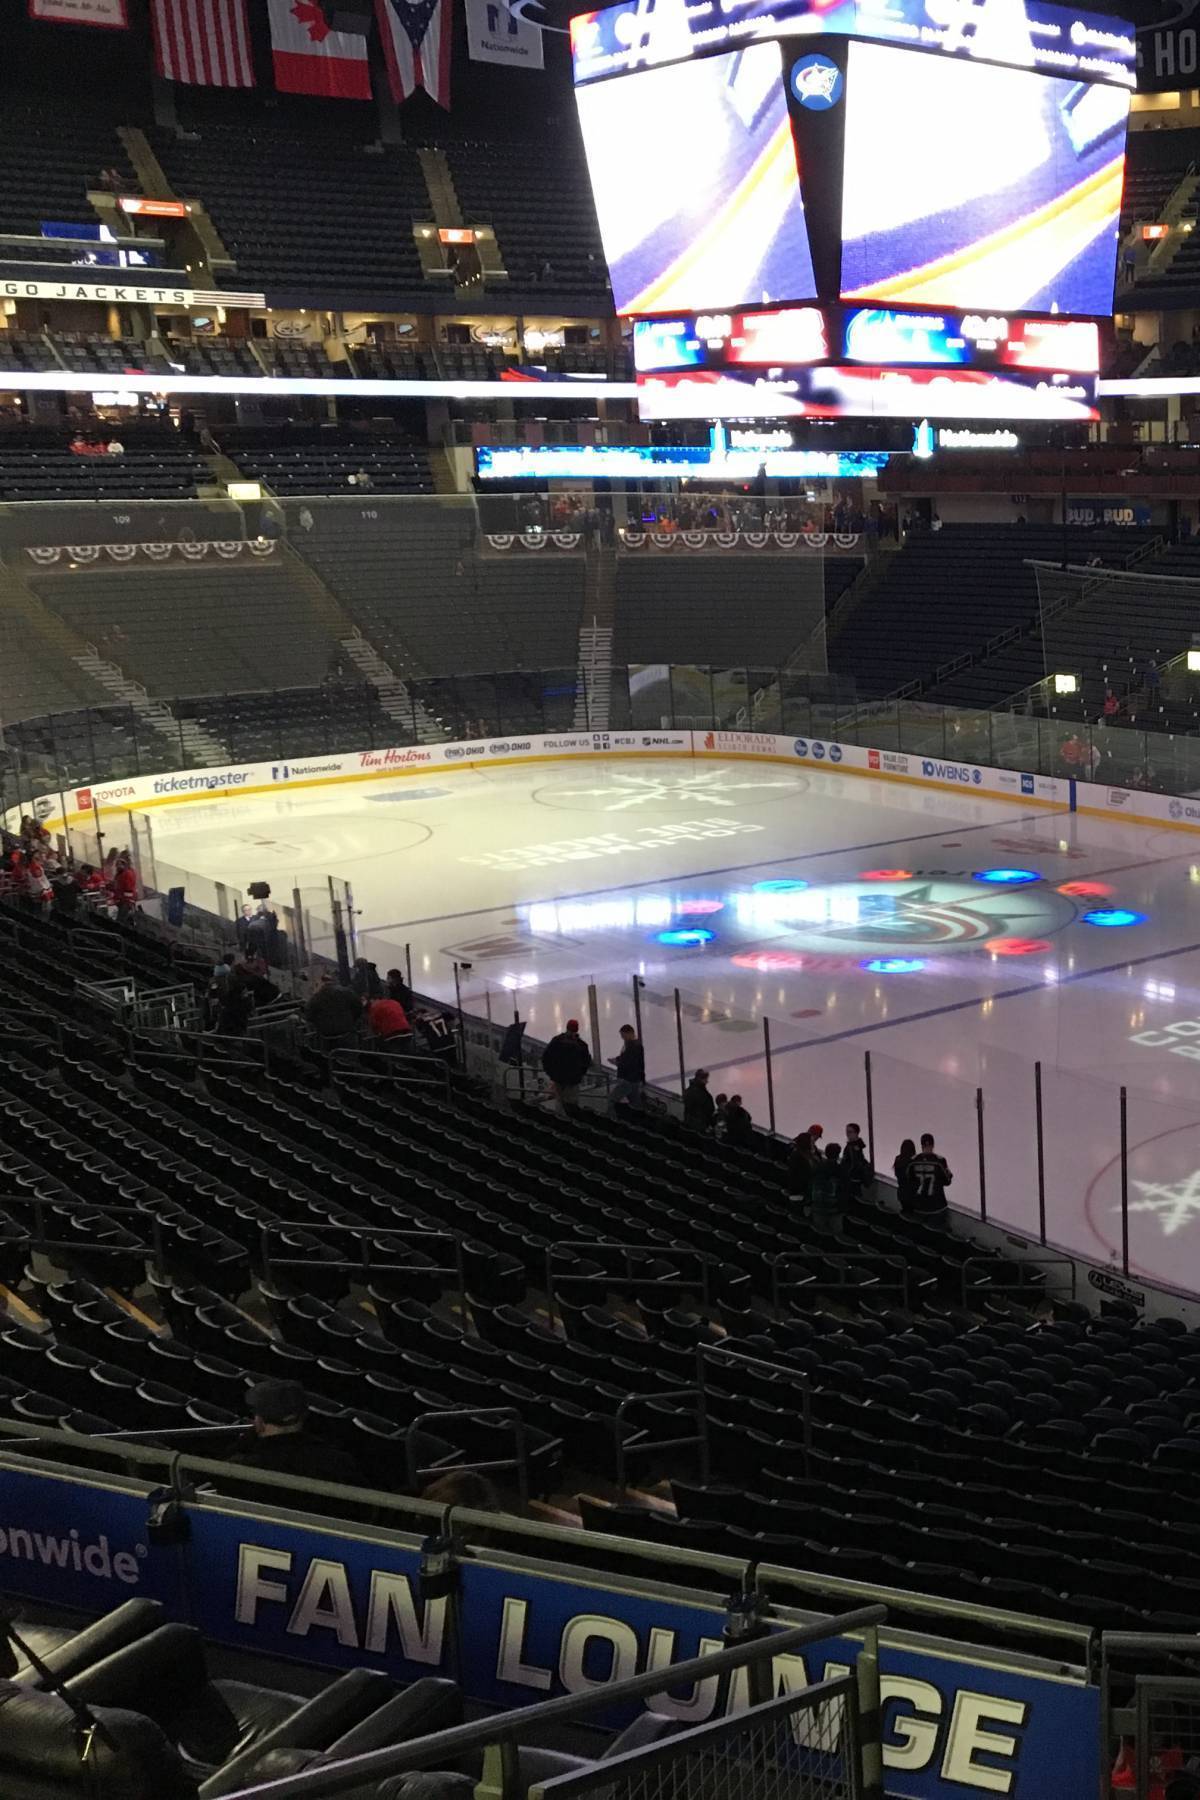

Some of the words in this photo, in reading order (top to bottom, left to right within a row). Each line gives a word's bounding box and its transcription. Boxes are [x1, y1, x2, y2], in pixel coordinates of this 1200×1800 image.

[481, 40, 529, 56] Nationwide
[4, 282, 39, 296] GO
[56, 286, 186, 303] JACKETS
[113, 515, 131, 525] 109
[361, 510, 378, 520] 110
[1103, 508, 1134, 521] BUD
[543, 740, 576, 748] FOLLOW
[718, 733, 777, 745] ELDORADO
[360, 752, 383, 767] Tim
[384, 747, 432, 763] Hortons
[291, 764, 341, 776] Nationwide
[935, 764, 970, 782] WBNS
[153, 770, 249, 794] ticketmaster
[95, 787, 136, 801] TOYOTA
[915, 1172, 936, 1197] 77
[234, 1542, 450, 1667] FAN
[495, 1595, 1028, 1795] LOUNGE
